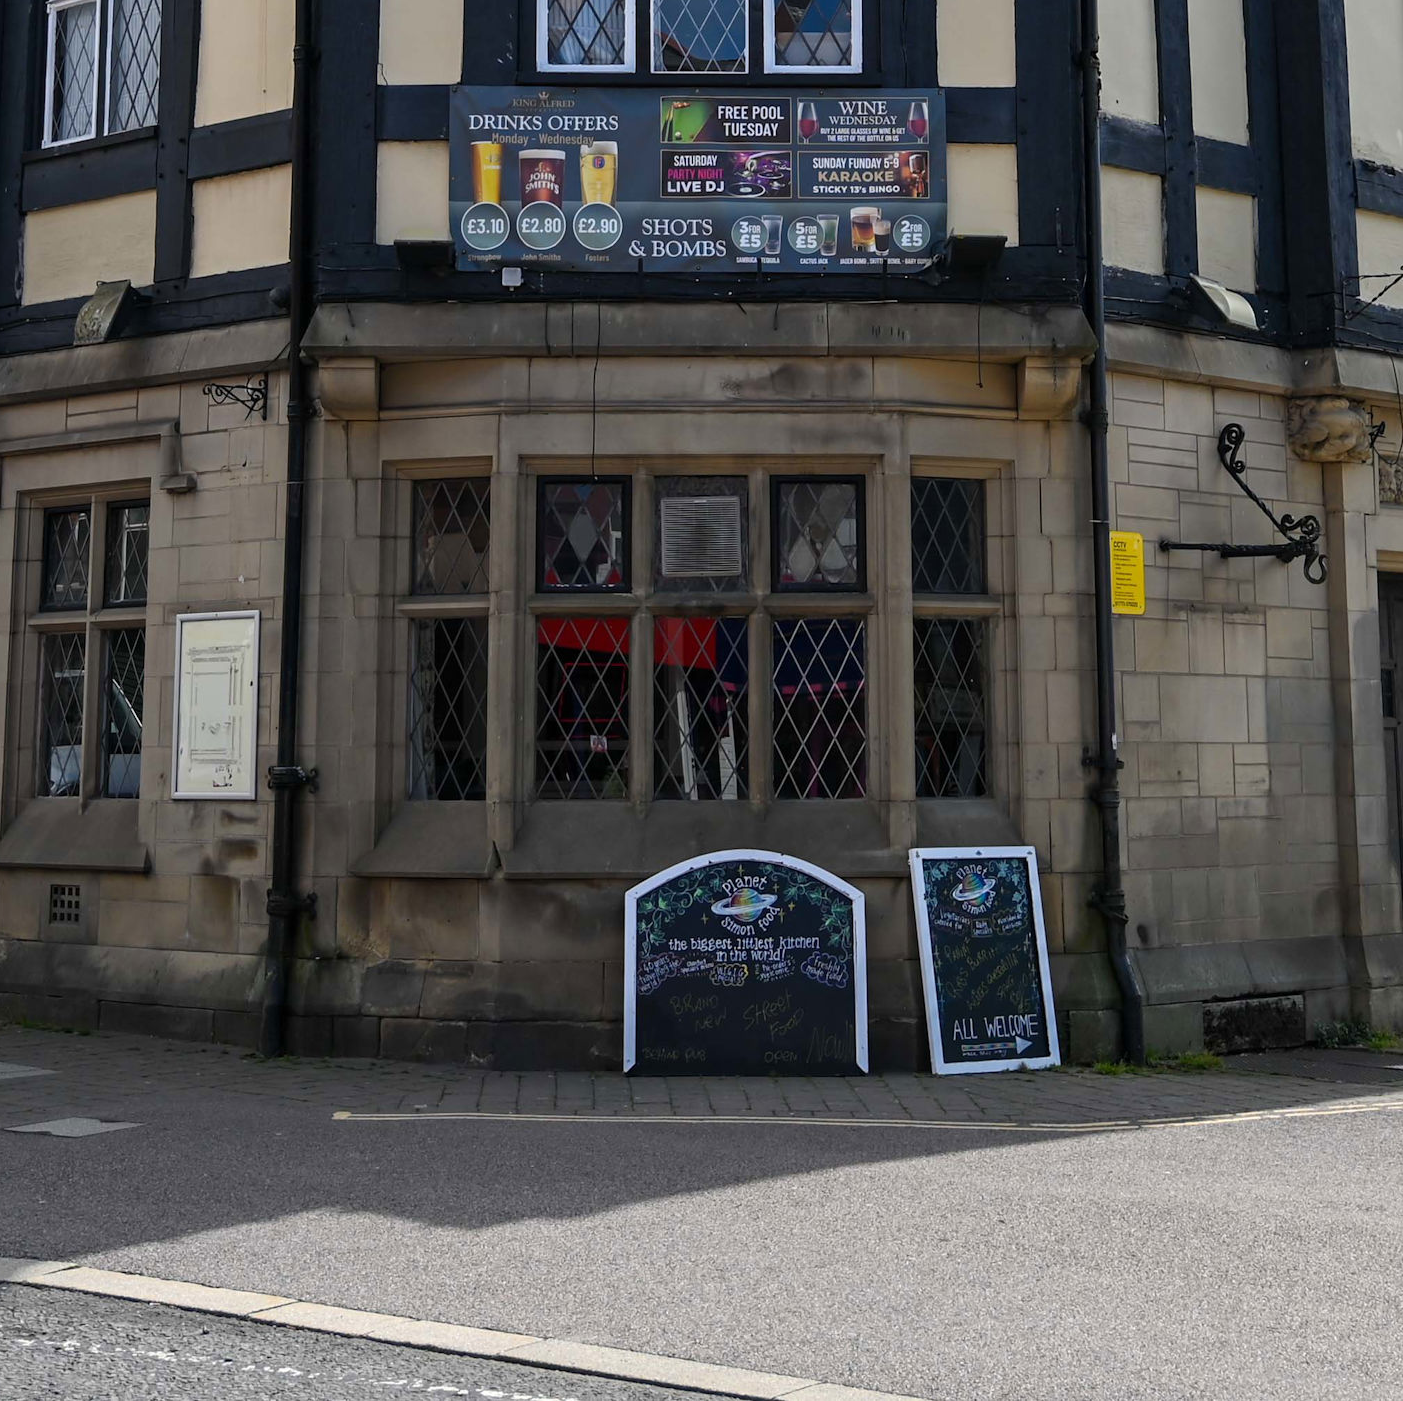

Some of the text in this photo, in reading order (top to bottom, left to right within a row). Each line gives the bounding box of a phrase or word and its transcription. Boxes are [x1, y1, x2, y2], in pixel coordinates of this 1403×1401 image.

[512, 98, 575, 108] KING ALFRED
[838, 101, 888, 115] WINE
[718, 105, 784, 120] FREE POOL
[468, 114, 619, 131] DRINKS OFFERS
[829, 115, 897, 125] WEDNESDAY
[723, 122, 778, 137] TUESDAY
[492, 132, 595, 147] Monday Wednesday
[673, 155, 717, 167] SATURDAY
[812, 157, 900, 169] SUNDAY FUNDAY 5-9
[528, 172, 556, 184] JOHN
[667, 168, 724, 180] PARTY NIGHT
[818, 171, 895, 182] KARAOKE
[525, 181, 560, 196] SMITH'S
[667, 181, 725, 193] LIVE DJ
[812, 185, 900, 194] STICKY 13's BINGO
[467, 218, 504, 234] £3.10
[521, 217, 562, 234] £2.80
[578, 217, 618, 234] £2.90
[641, 218, 713, 236] SHOTS
[739, 234, 761, 247] £5
[795, 235, 817, 248] £5
[901, 233, 923, 247] £5
[628, 239, 727, 257] & BOMBS
[521, 253, 537, 261] John
[1113, 541, 1127, 549] CCTV
[956, 864, 988, 880] Planet
[722, 876, 767, 896] Planet
[721, 905, 780, 935] Simon food
[668, 938, 687, 950] the
[737, 937, 774, 950] littlest
[779, 936, 820, 950] kitchen
[716, 949, 785, 961] in the world!
[953, 1013, 1039, 1041] ALL WELCOME
